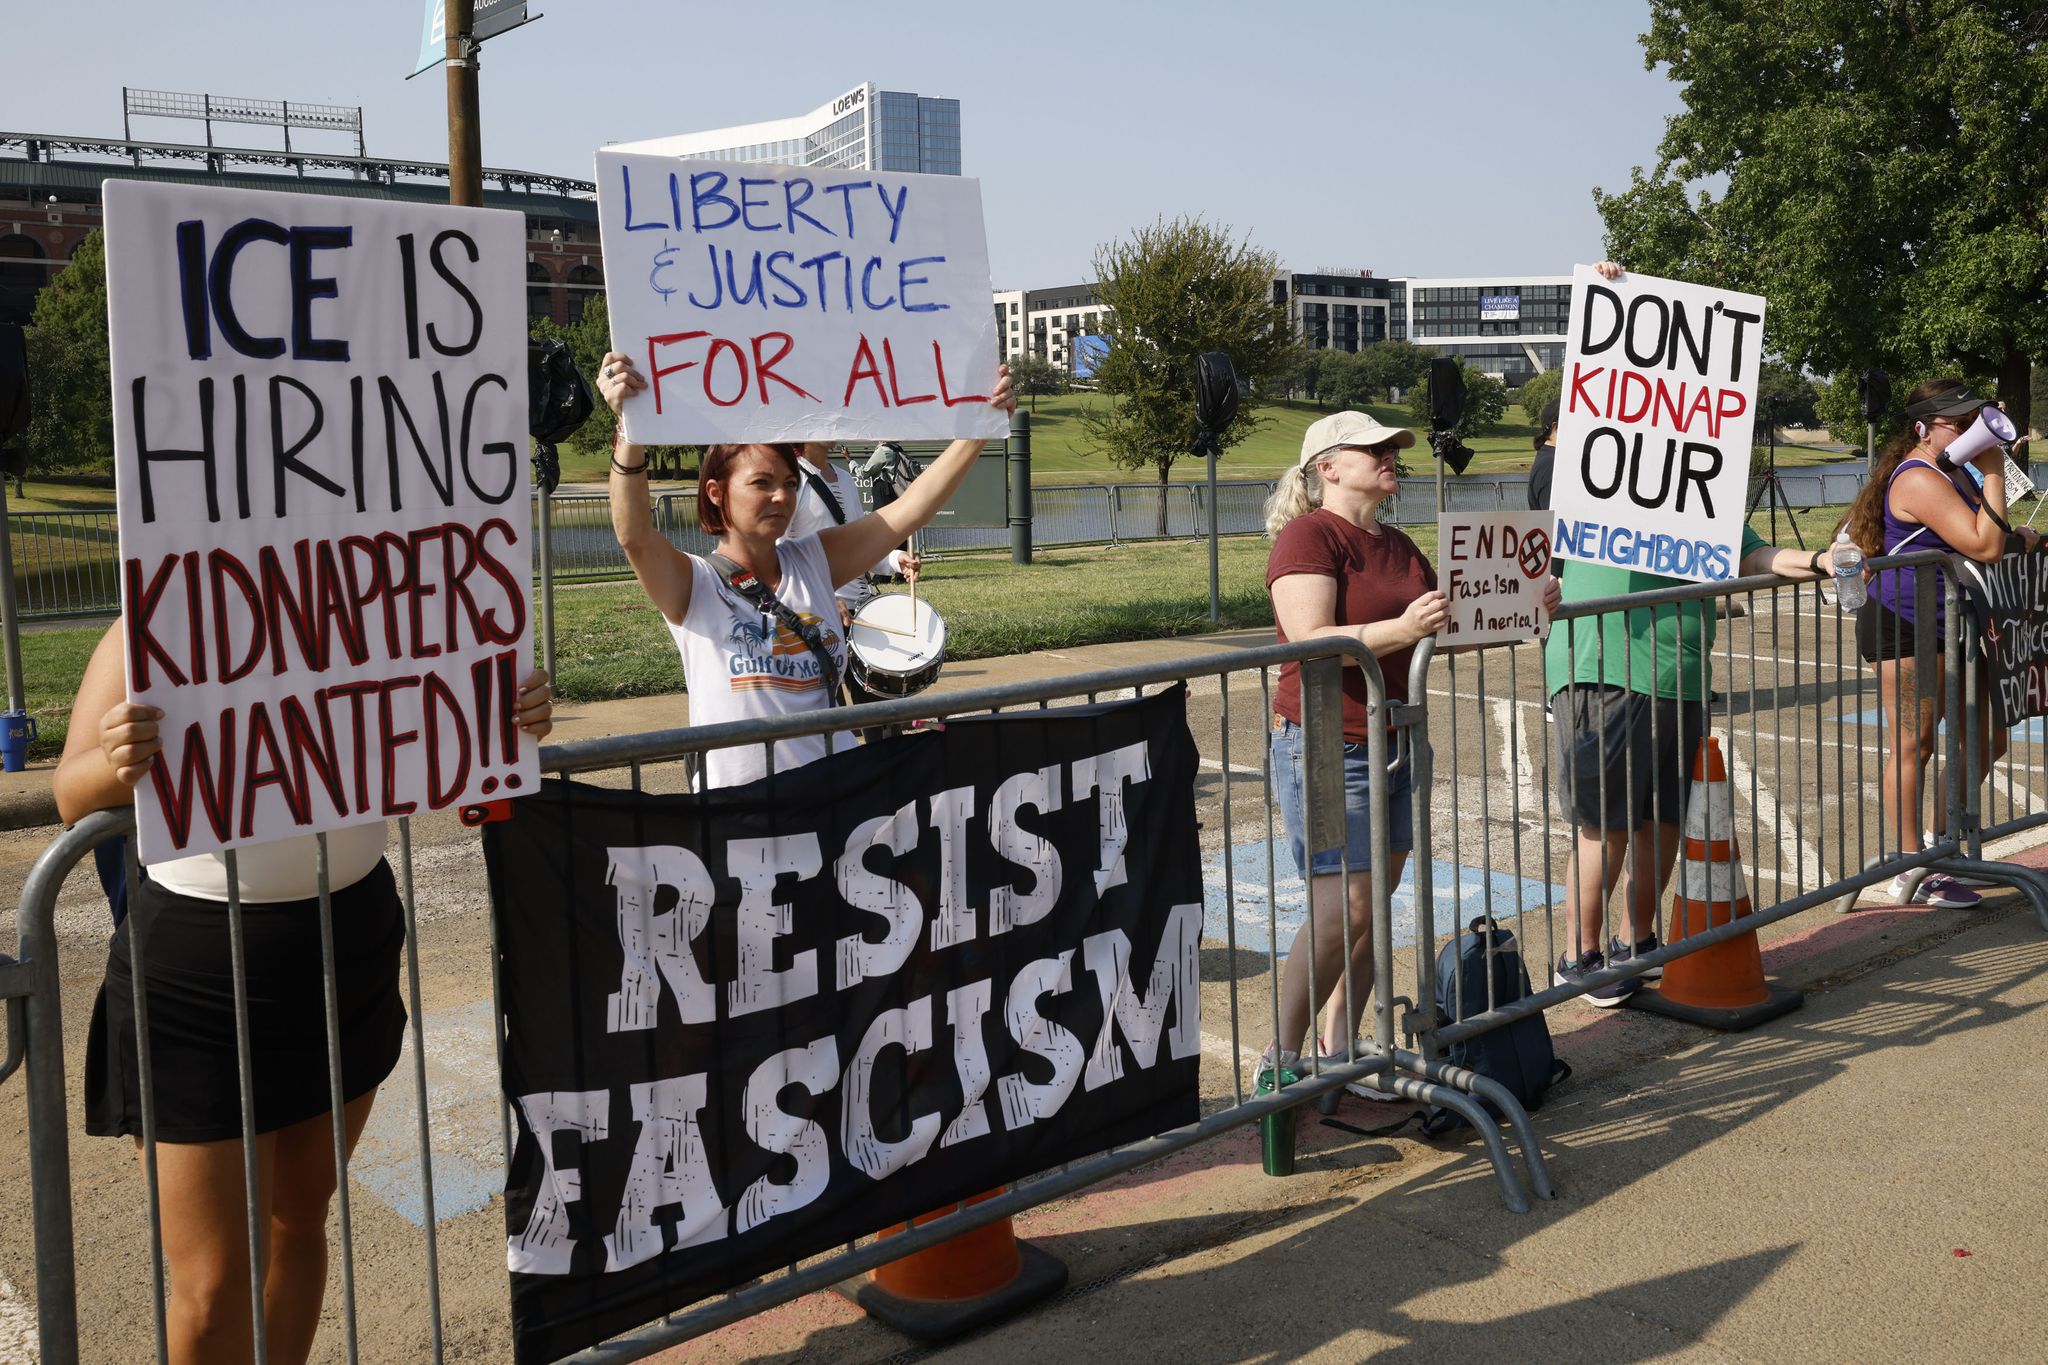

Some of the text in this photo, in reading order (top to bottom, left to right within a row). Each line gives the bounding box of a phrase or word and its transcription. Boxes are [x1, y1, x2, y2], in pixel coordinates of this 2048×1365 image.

[833, 88, 865, 115] LOEWS
[622, 165, 908, 243] LIBERTY
[176, 218, 483, 361] ICE IS
[649, 238, 951, 313] & JUSTICE
[645, 330, 992, 414] FOR ALL
[1580, 284, 1761, 382] DON'T
[1569, 362, 1747, 439] KIDNAP
[132, 370, 517, 523] HIRING
[1580, 426, 1723, 519] OUR
[1451, 525, 1519, 560] END
[125, 517, 526, 692] KIDNAPPERS
[1450, 569, 1519, 601] Fascism
[1474, 607, 1540, 635] America!
[730, 654, 774, 675] Gulf
[147, 649, 523, 850] WANTED!!
[605, 740, 1155, 1033] RESIST
[507, 903, 1203, 1275] FASCISM
